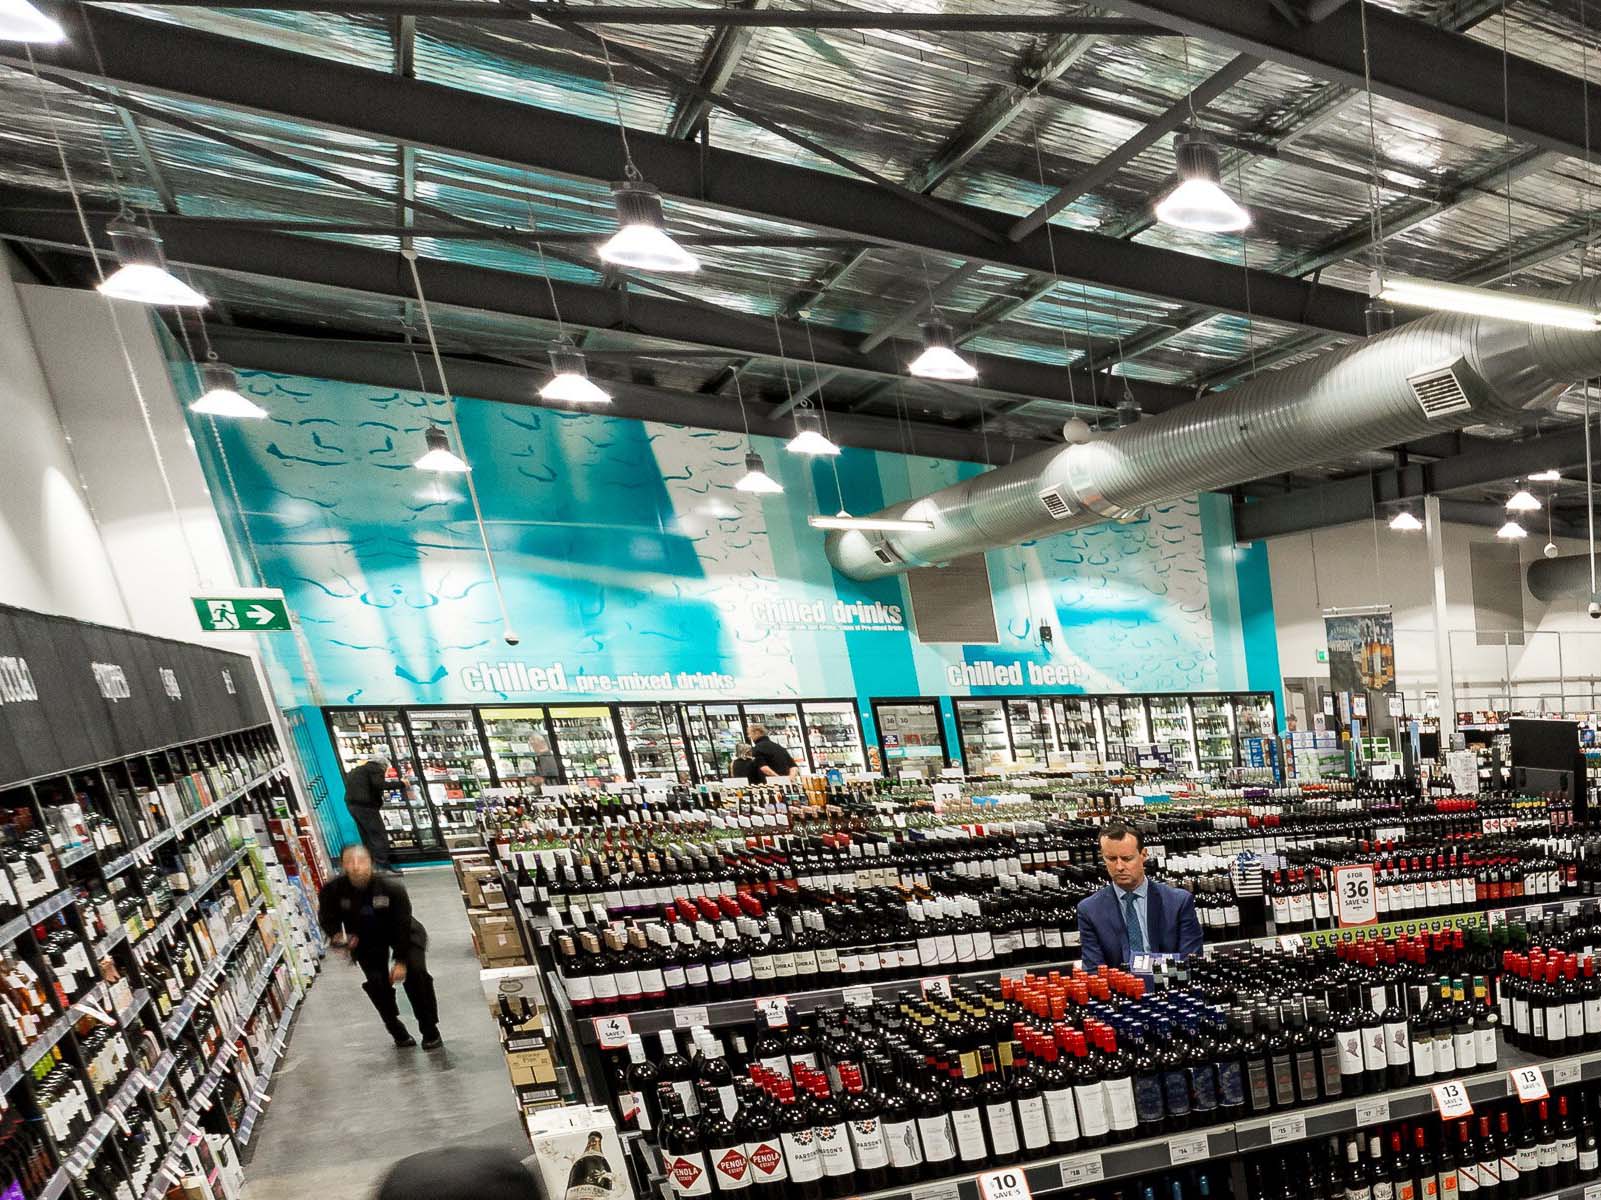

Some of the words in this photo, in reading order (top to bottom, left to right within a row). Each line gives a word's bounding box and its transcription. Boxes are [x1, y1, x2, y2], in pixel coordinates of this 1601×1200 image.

[831, 600, 901, 624] drinks
[462, 661, 568, 692] chilled
[576, 671, 673, 692] pre-mixed
[678, 671, 736, 691] drinks
[947, 661, 1022, 687] chilled
[1343, 881, 1369, 899] $36
[753, 1153, 780, 1164] PENOLA
[759, 1160, 776, 1168] ESTATE
[993, 1190, 1013, 1199] SAVE
